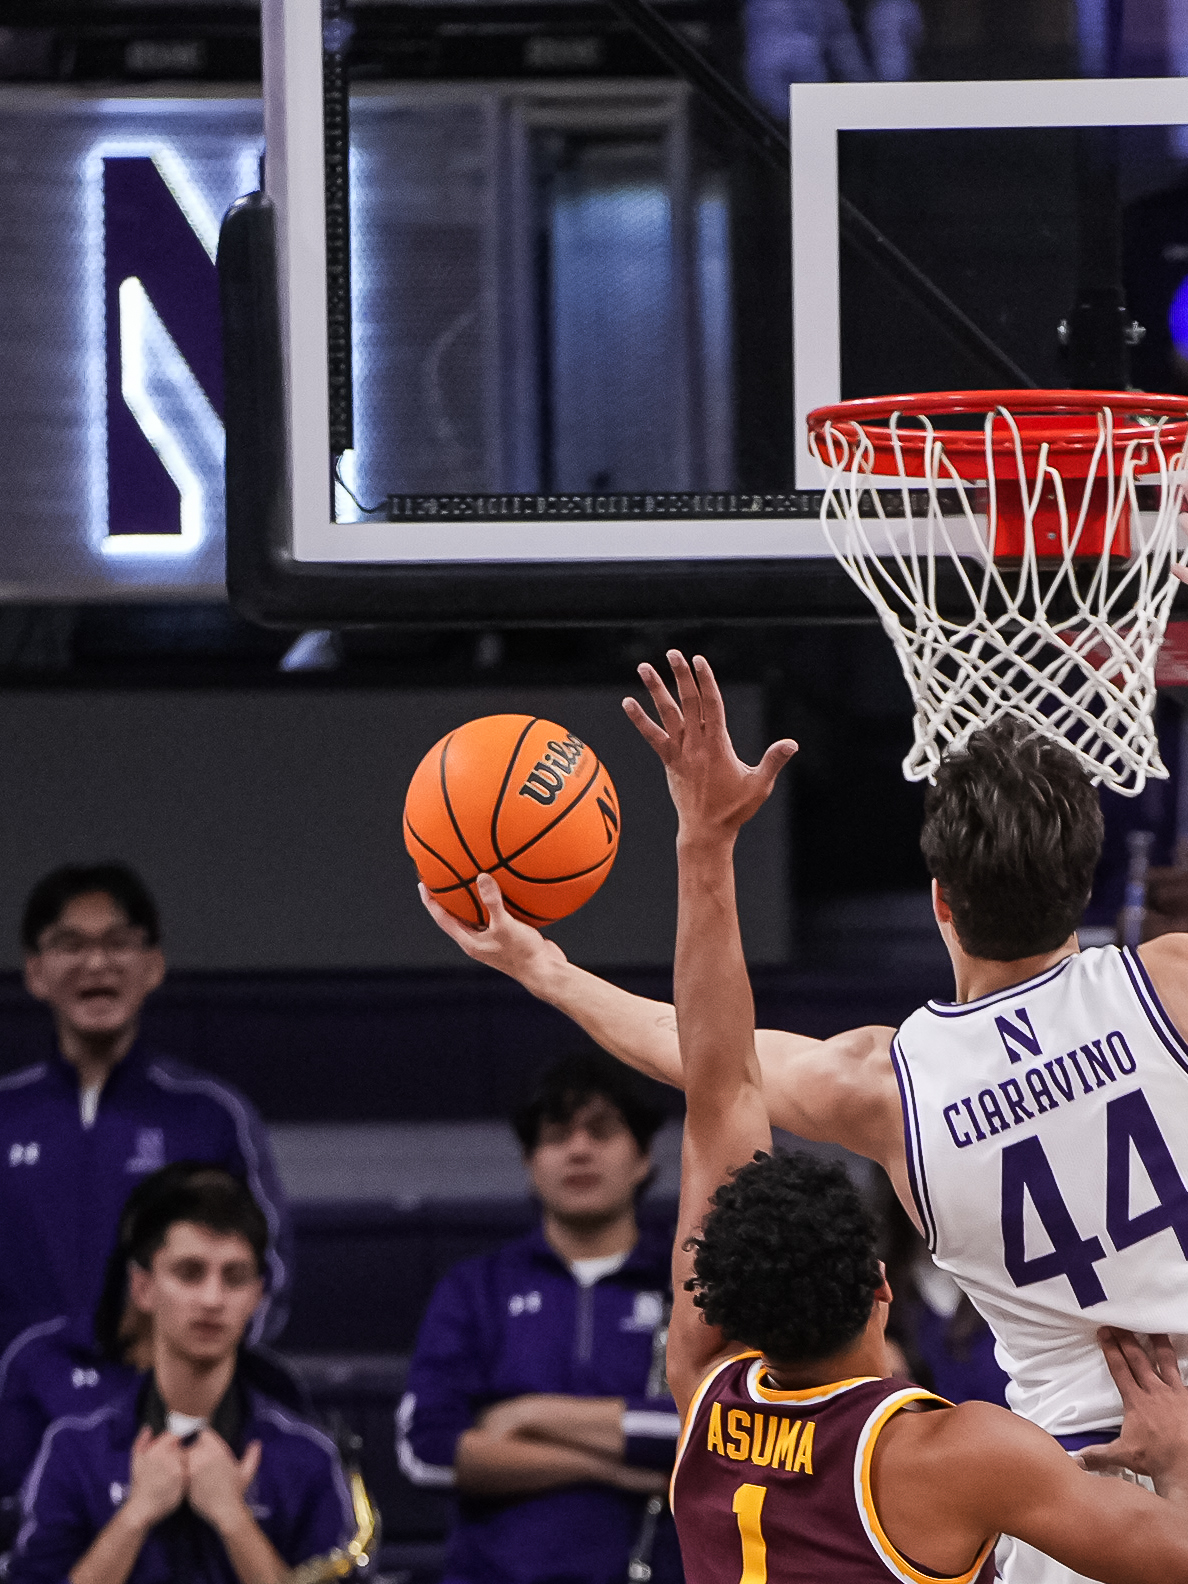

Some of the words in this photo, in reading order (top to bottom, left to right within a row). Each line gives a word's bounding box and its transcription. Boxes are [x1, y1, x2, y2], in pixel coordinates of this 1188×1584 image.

[994, 1007, 1044, 1065] N
[942, 1030, 1137, 1149] CIARAVINO
[707, 1401, 816, 1475] ASUMA
